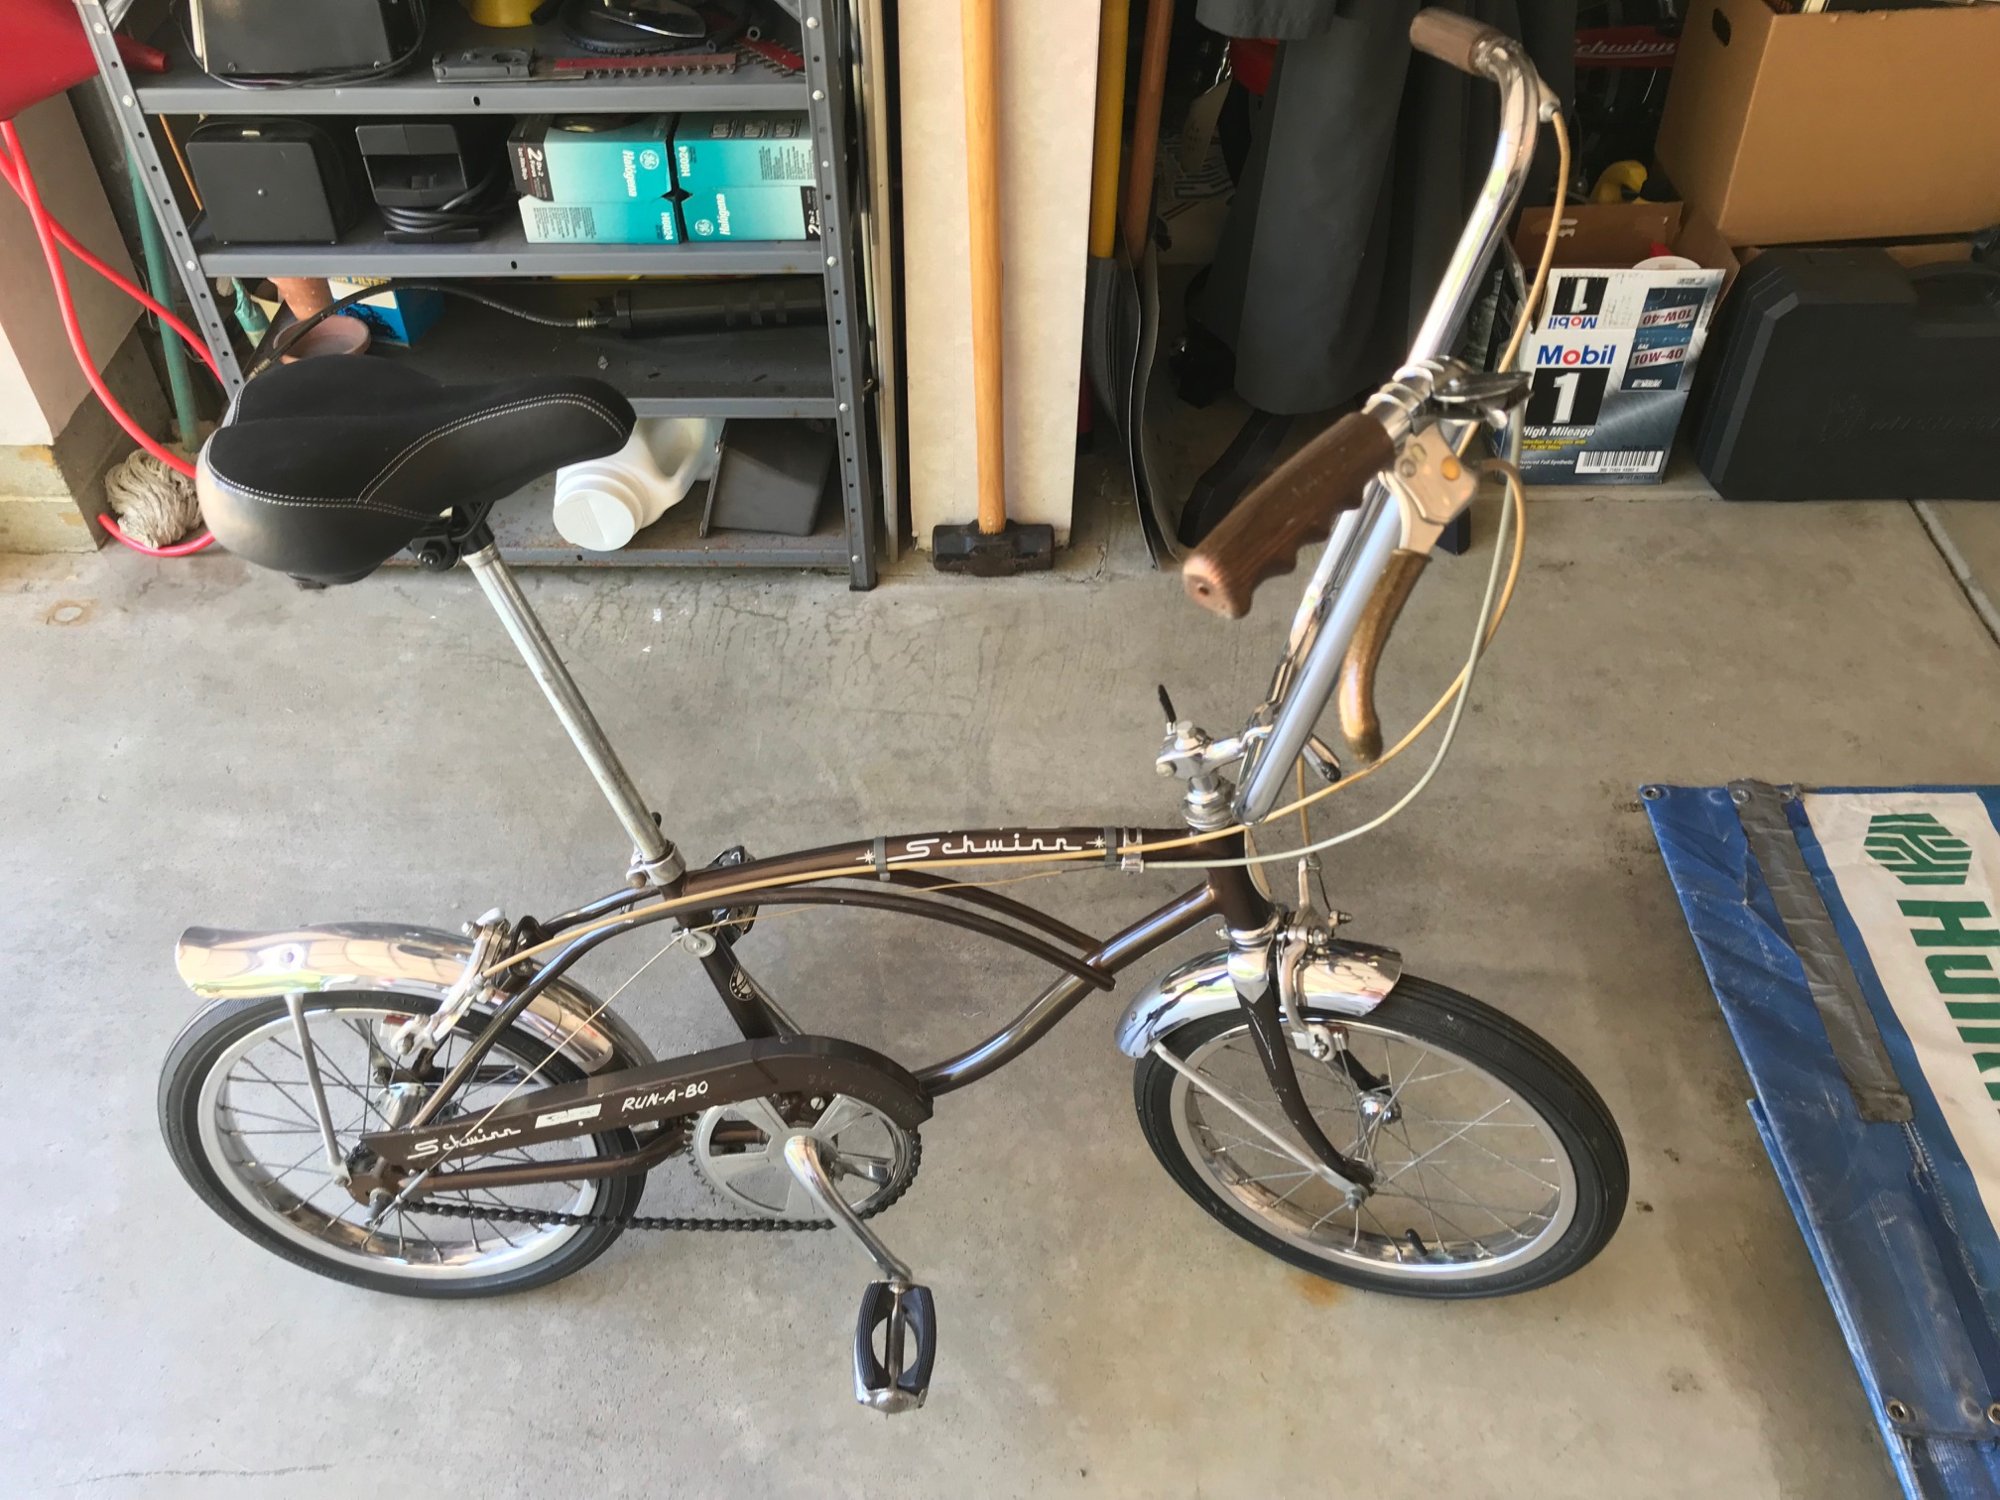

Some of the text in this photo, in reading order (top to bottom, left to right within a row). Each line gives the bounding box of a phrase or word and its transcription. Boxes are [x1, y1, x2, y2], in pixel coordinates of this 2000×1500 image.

[1575, 38, 1677, 55] chwinn
[1570, 278, 1588, 314] 1
[1548, 314, 1597, 329] Mobil
[1642, 309, 1692, 325] 10W-40
[1536, 345, 1617, 365] Mobil
[1633, 348, 1684, 365] 10W-40
[1552, 372, 1581, 424] 1
[1549, 426, 1595, 438] Mileage
[887, 833, 1083, 862] Schwinn
[622, 1080, 709, 1112] RUN-A-BO
[407, 1127, 521, 1160] Schwinn
